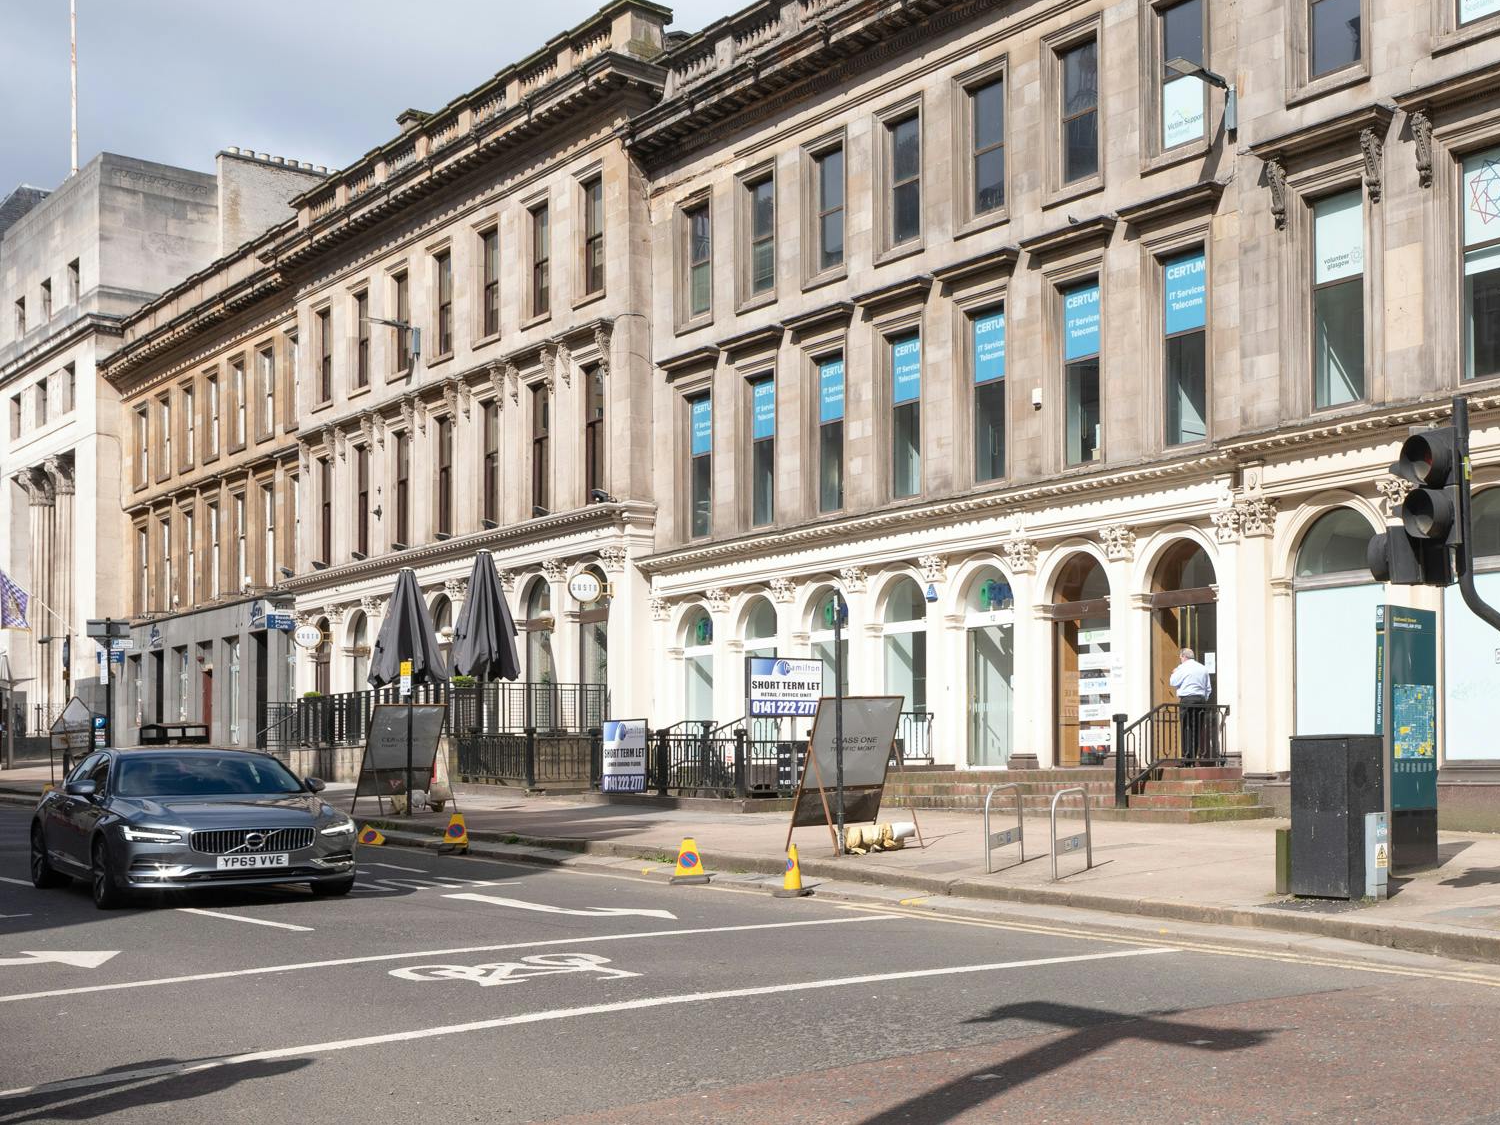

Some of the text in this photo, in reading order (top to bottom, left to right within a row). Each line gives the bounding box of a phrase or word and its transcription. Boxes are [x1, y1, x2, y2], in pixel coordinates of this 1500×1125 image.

[1167, 260, 1205, 280] CERTUM
[1177, 285, 1206, 299] Services
[1171, 298, 1203, 311] Telecoms
[895, 341, 920, 357] CERTU
[822, 365, 843, 378] CERTU
[787, 664, 820, 672] hamilton
[752, 681, 821, 690] SHORT TERM LET
[752, 700, 776, 714] 0141
[777, 701, 797, 714] 222
[96, 717, 103, 726] P
[832, 736, 879, 744] CASS ONE
[604, 747, 645, 758] SHORT TERM LET
[604, 775, 644, 790] 0141 222 2777
[223, 855, 283, 867] YP69 VVE
